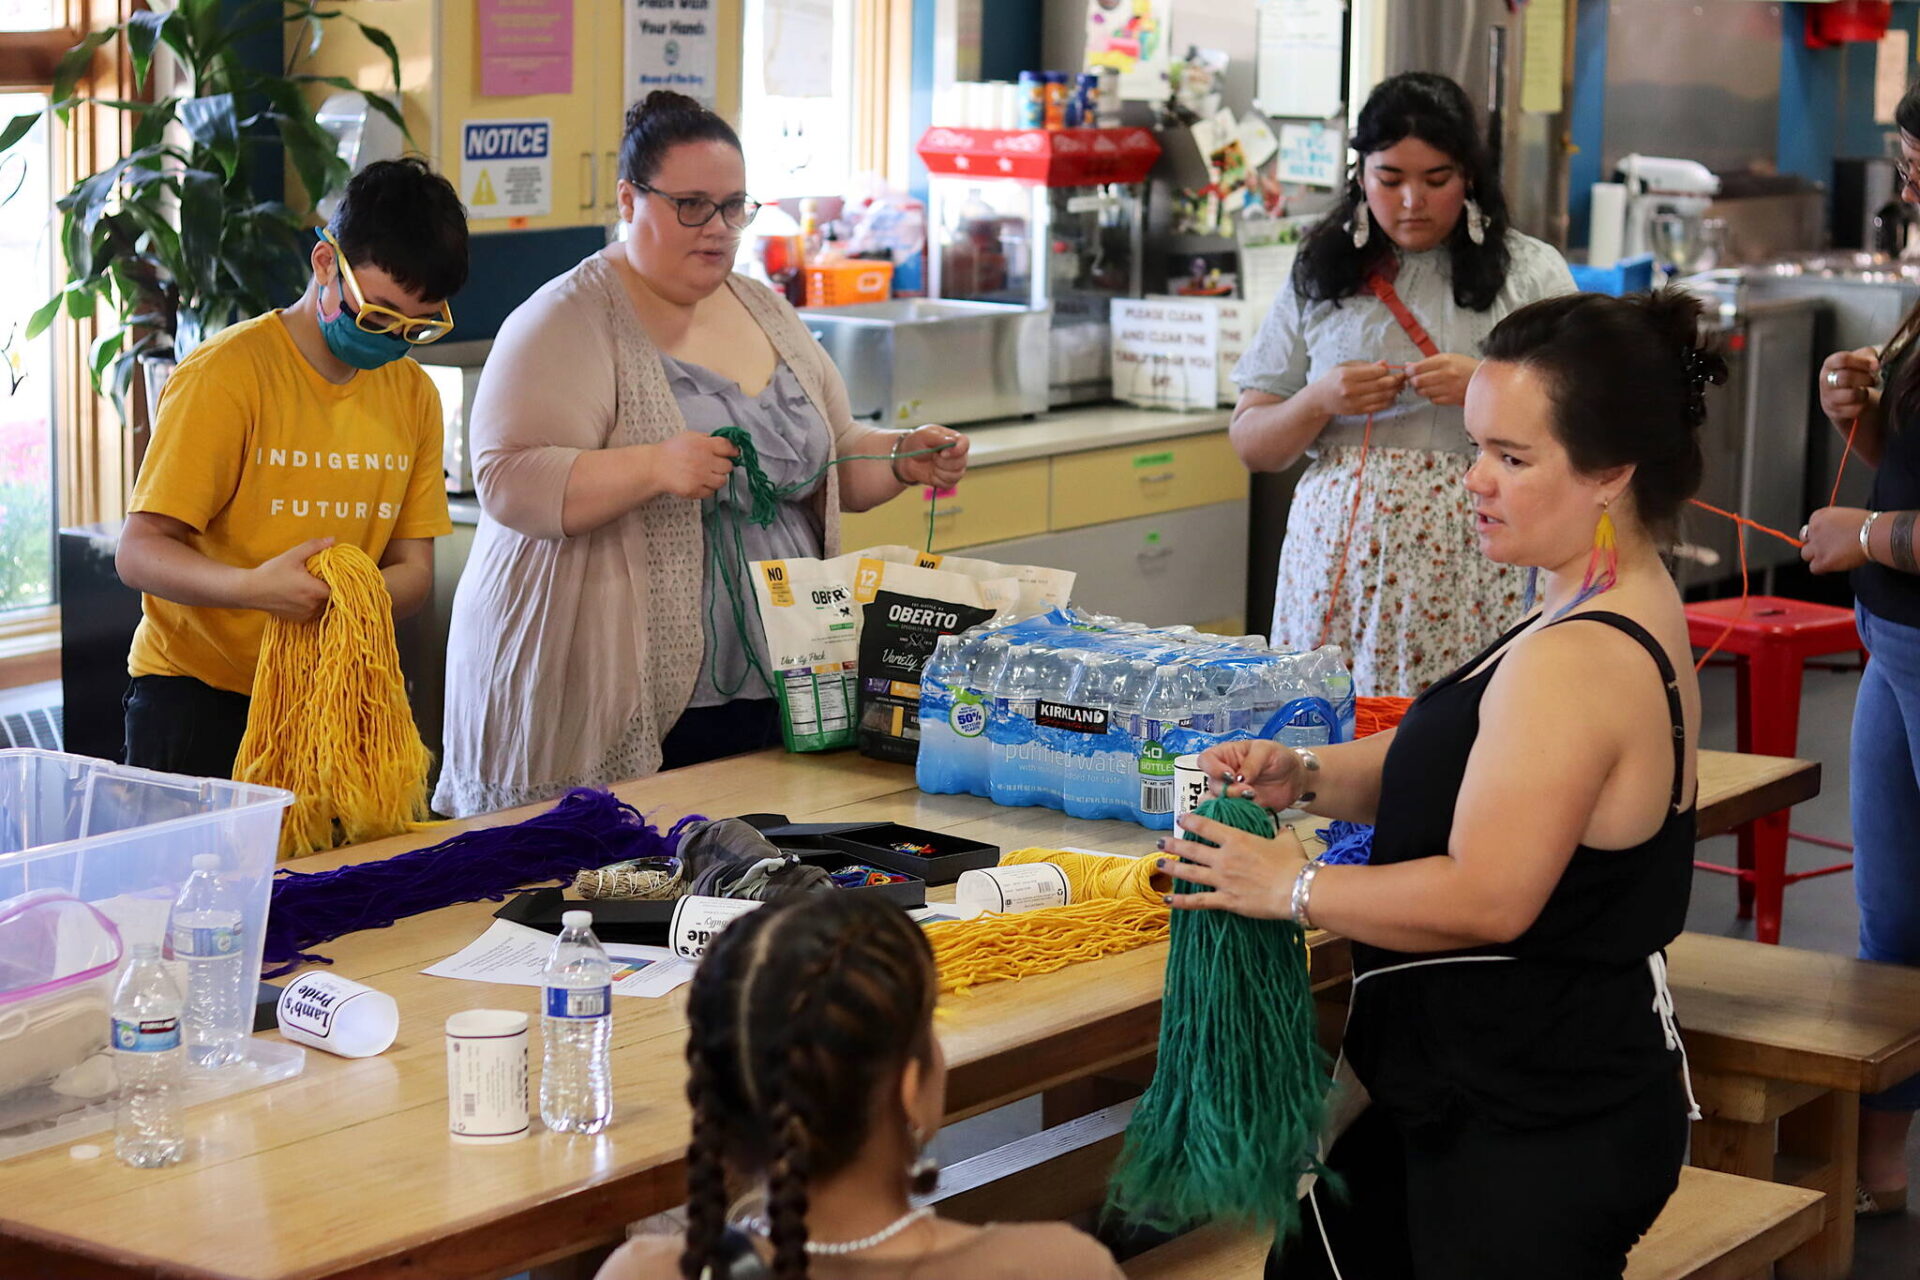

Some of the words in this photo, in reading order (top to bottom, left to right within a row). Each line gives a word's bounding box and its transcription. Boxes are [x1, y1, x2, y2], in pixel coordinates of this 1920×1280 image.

[639, 18, 666, 35] Your
[669, 19, 705, 36] Hands
[467, 127, 547, 155] NOTICE
[1125, 307, 1163, 320] PLEASE
[1168, 310, 1203, 323] CLEAN
[1122, 329, 1145, 341] AND
[1187, 332, 1206, 345] THE
[257, 448, 409, 471] INDIGENOU
[271, 499, 401, 519] FUTURS
[767, 567, 783, 581] NO
[861, 570, 877, 588] 12
[811, 587, 849, 605] OBER
[888, 604, 958, 630] OBERTO
[882, 648, 917, 672] Variety
[957, 711, 982, 725] 50%
[1040, 704, 1105, 724] KIRKLAND
[1143, 746, 1162, 759] 40
[1078, 755, 1135, 775] water
[1189, 783, 1202, 811] Pri
[298, 985, 336, 1009] Pride
[284, 997, 331, 1028] Lamb's
